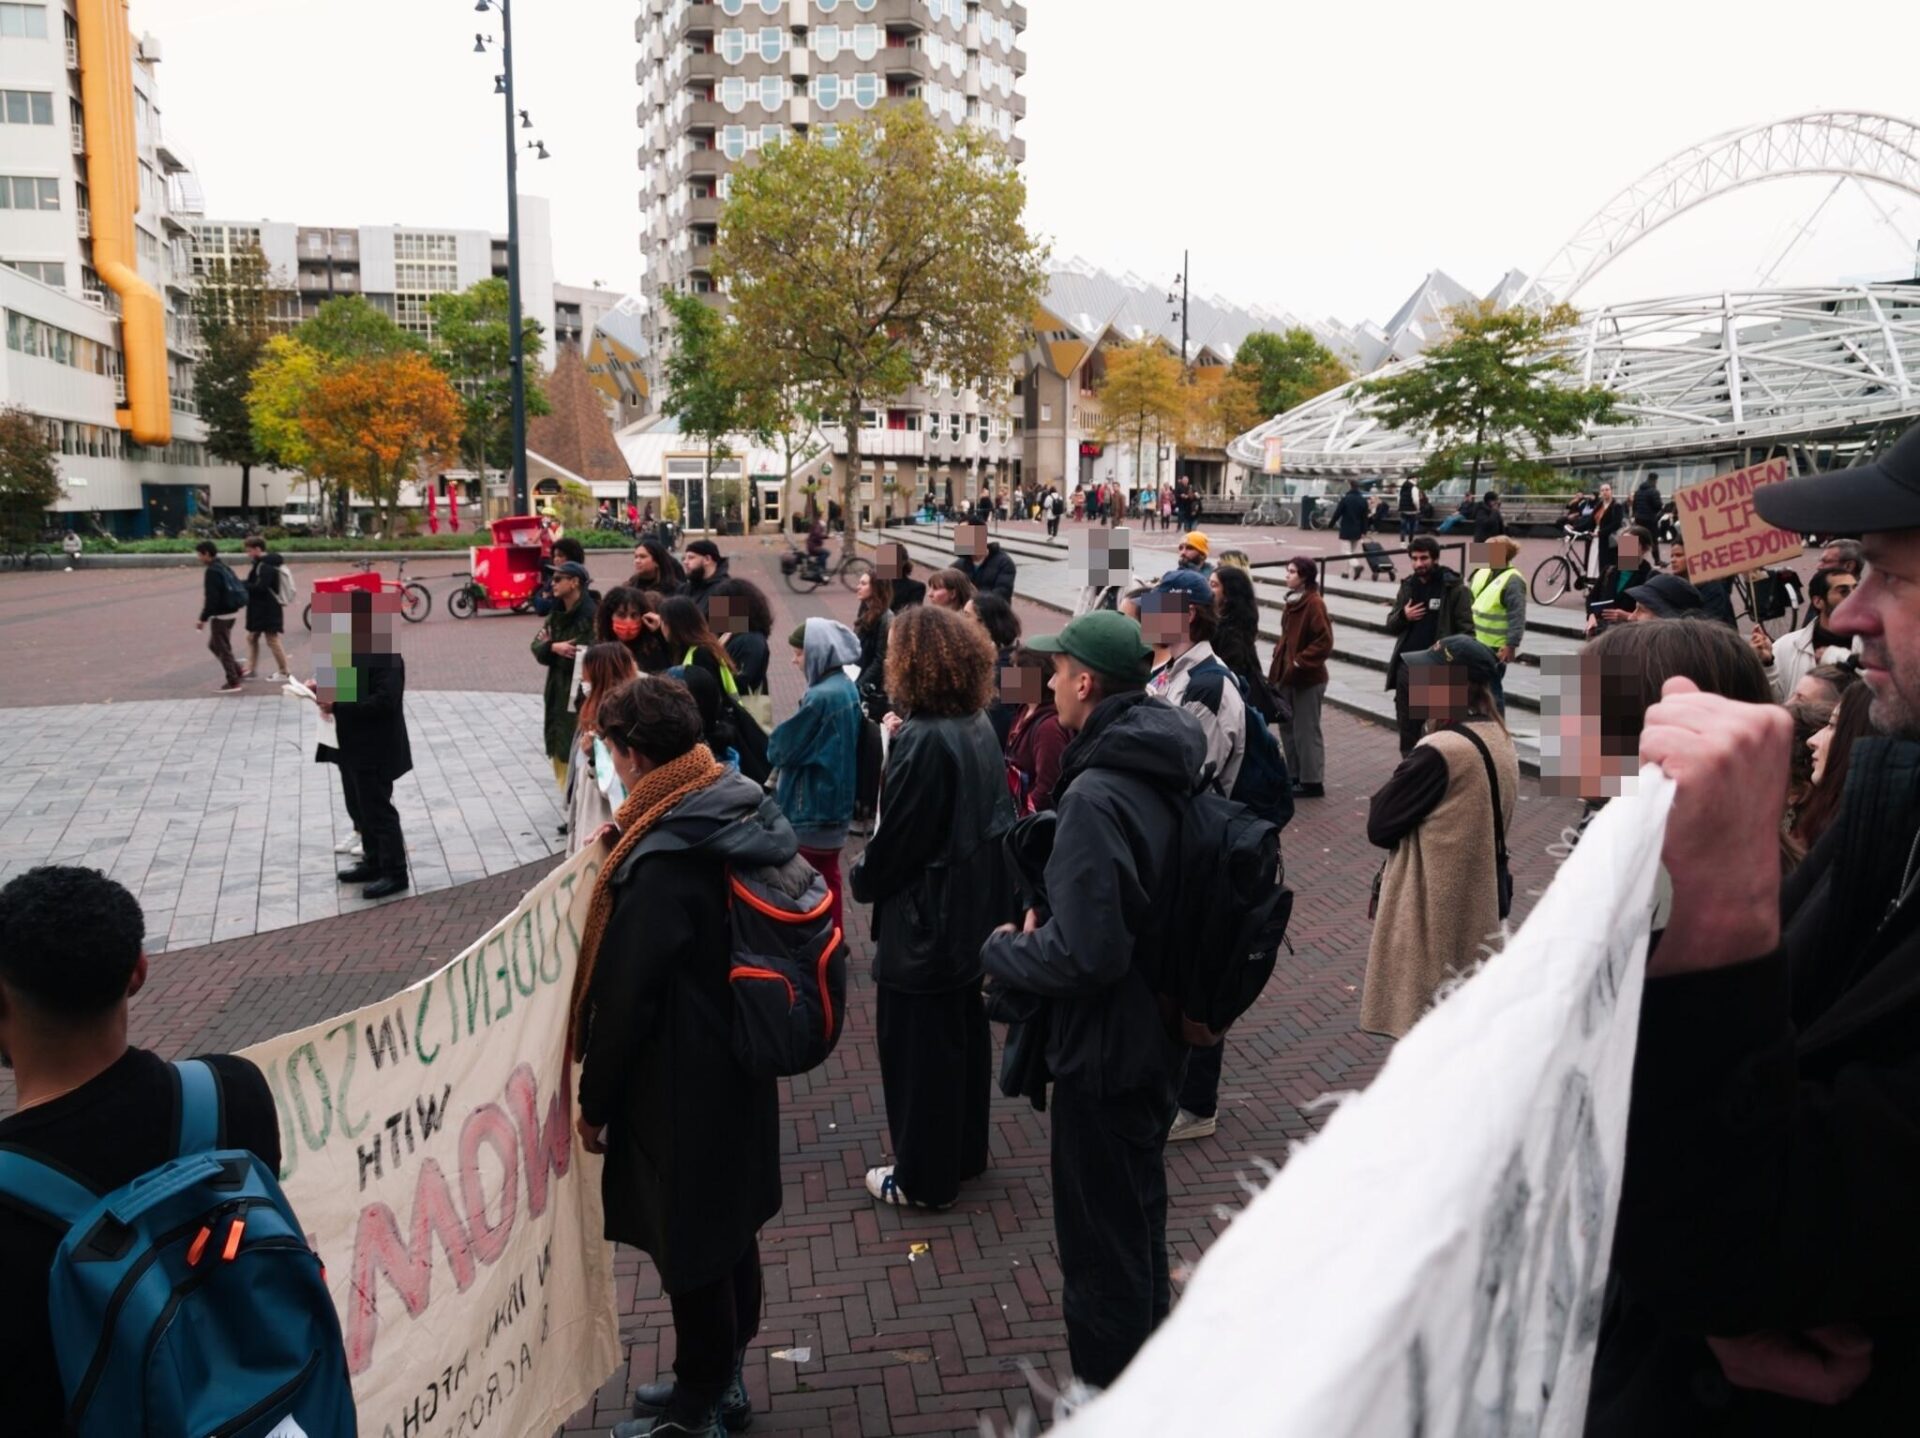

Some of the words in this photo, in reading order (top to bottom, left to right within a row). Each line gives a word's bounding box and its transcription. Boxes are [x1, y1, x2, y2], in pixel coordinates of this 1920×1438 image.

[1680, 461, 1786, 512] WOMEN
[1698, 501, 1756, 540] LIF
[1688, 529, 1800, 575] FREEDOM
